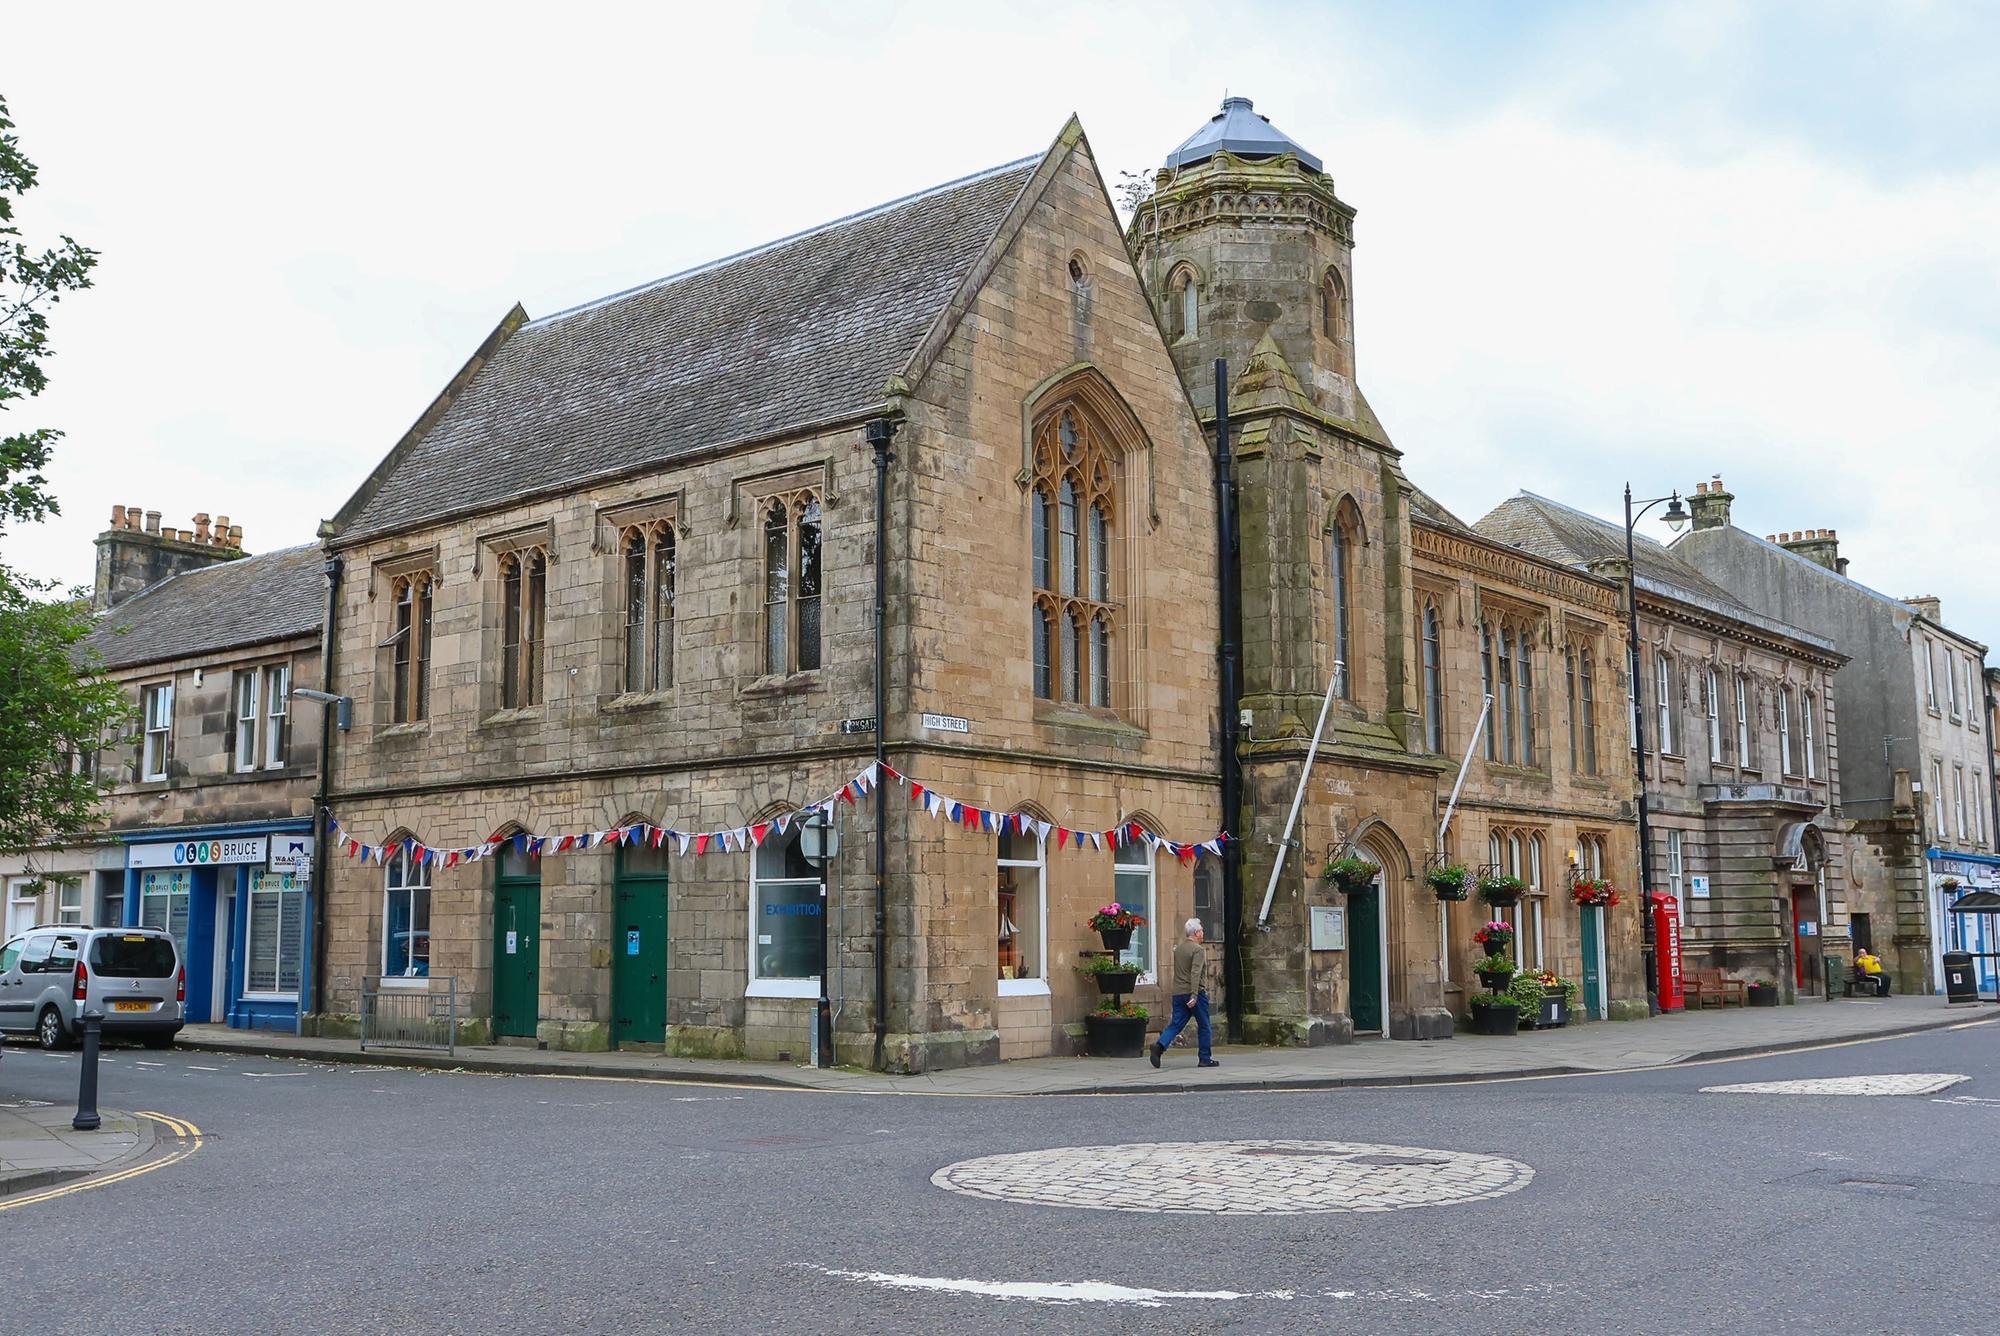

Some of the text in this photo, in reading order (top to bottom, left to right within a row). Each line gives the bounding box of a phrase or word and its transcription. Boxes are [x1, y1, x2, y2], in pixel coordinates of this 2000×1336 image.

[924, 714, 967, 730] HIGH STREET
[224, 842, 257, 856] BRUCE
[766, 903, 822, 916] EXHIBITION
